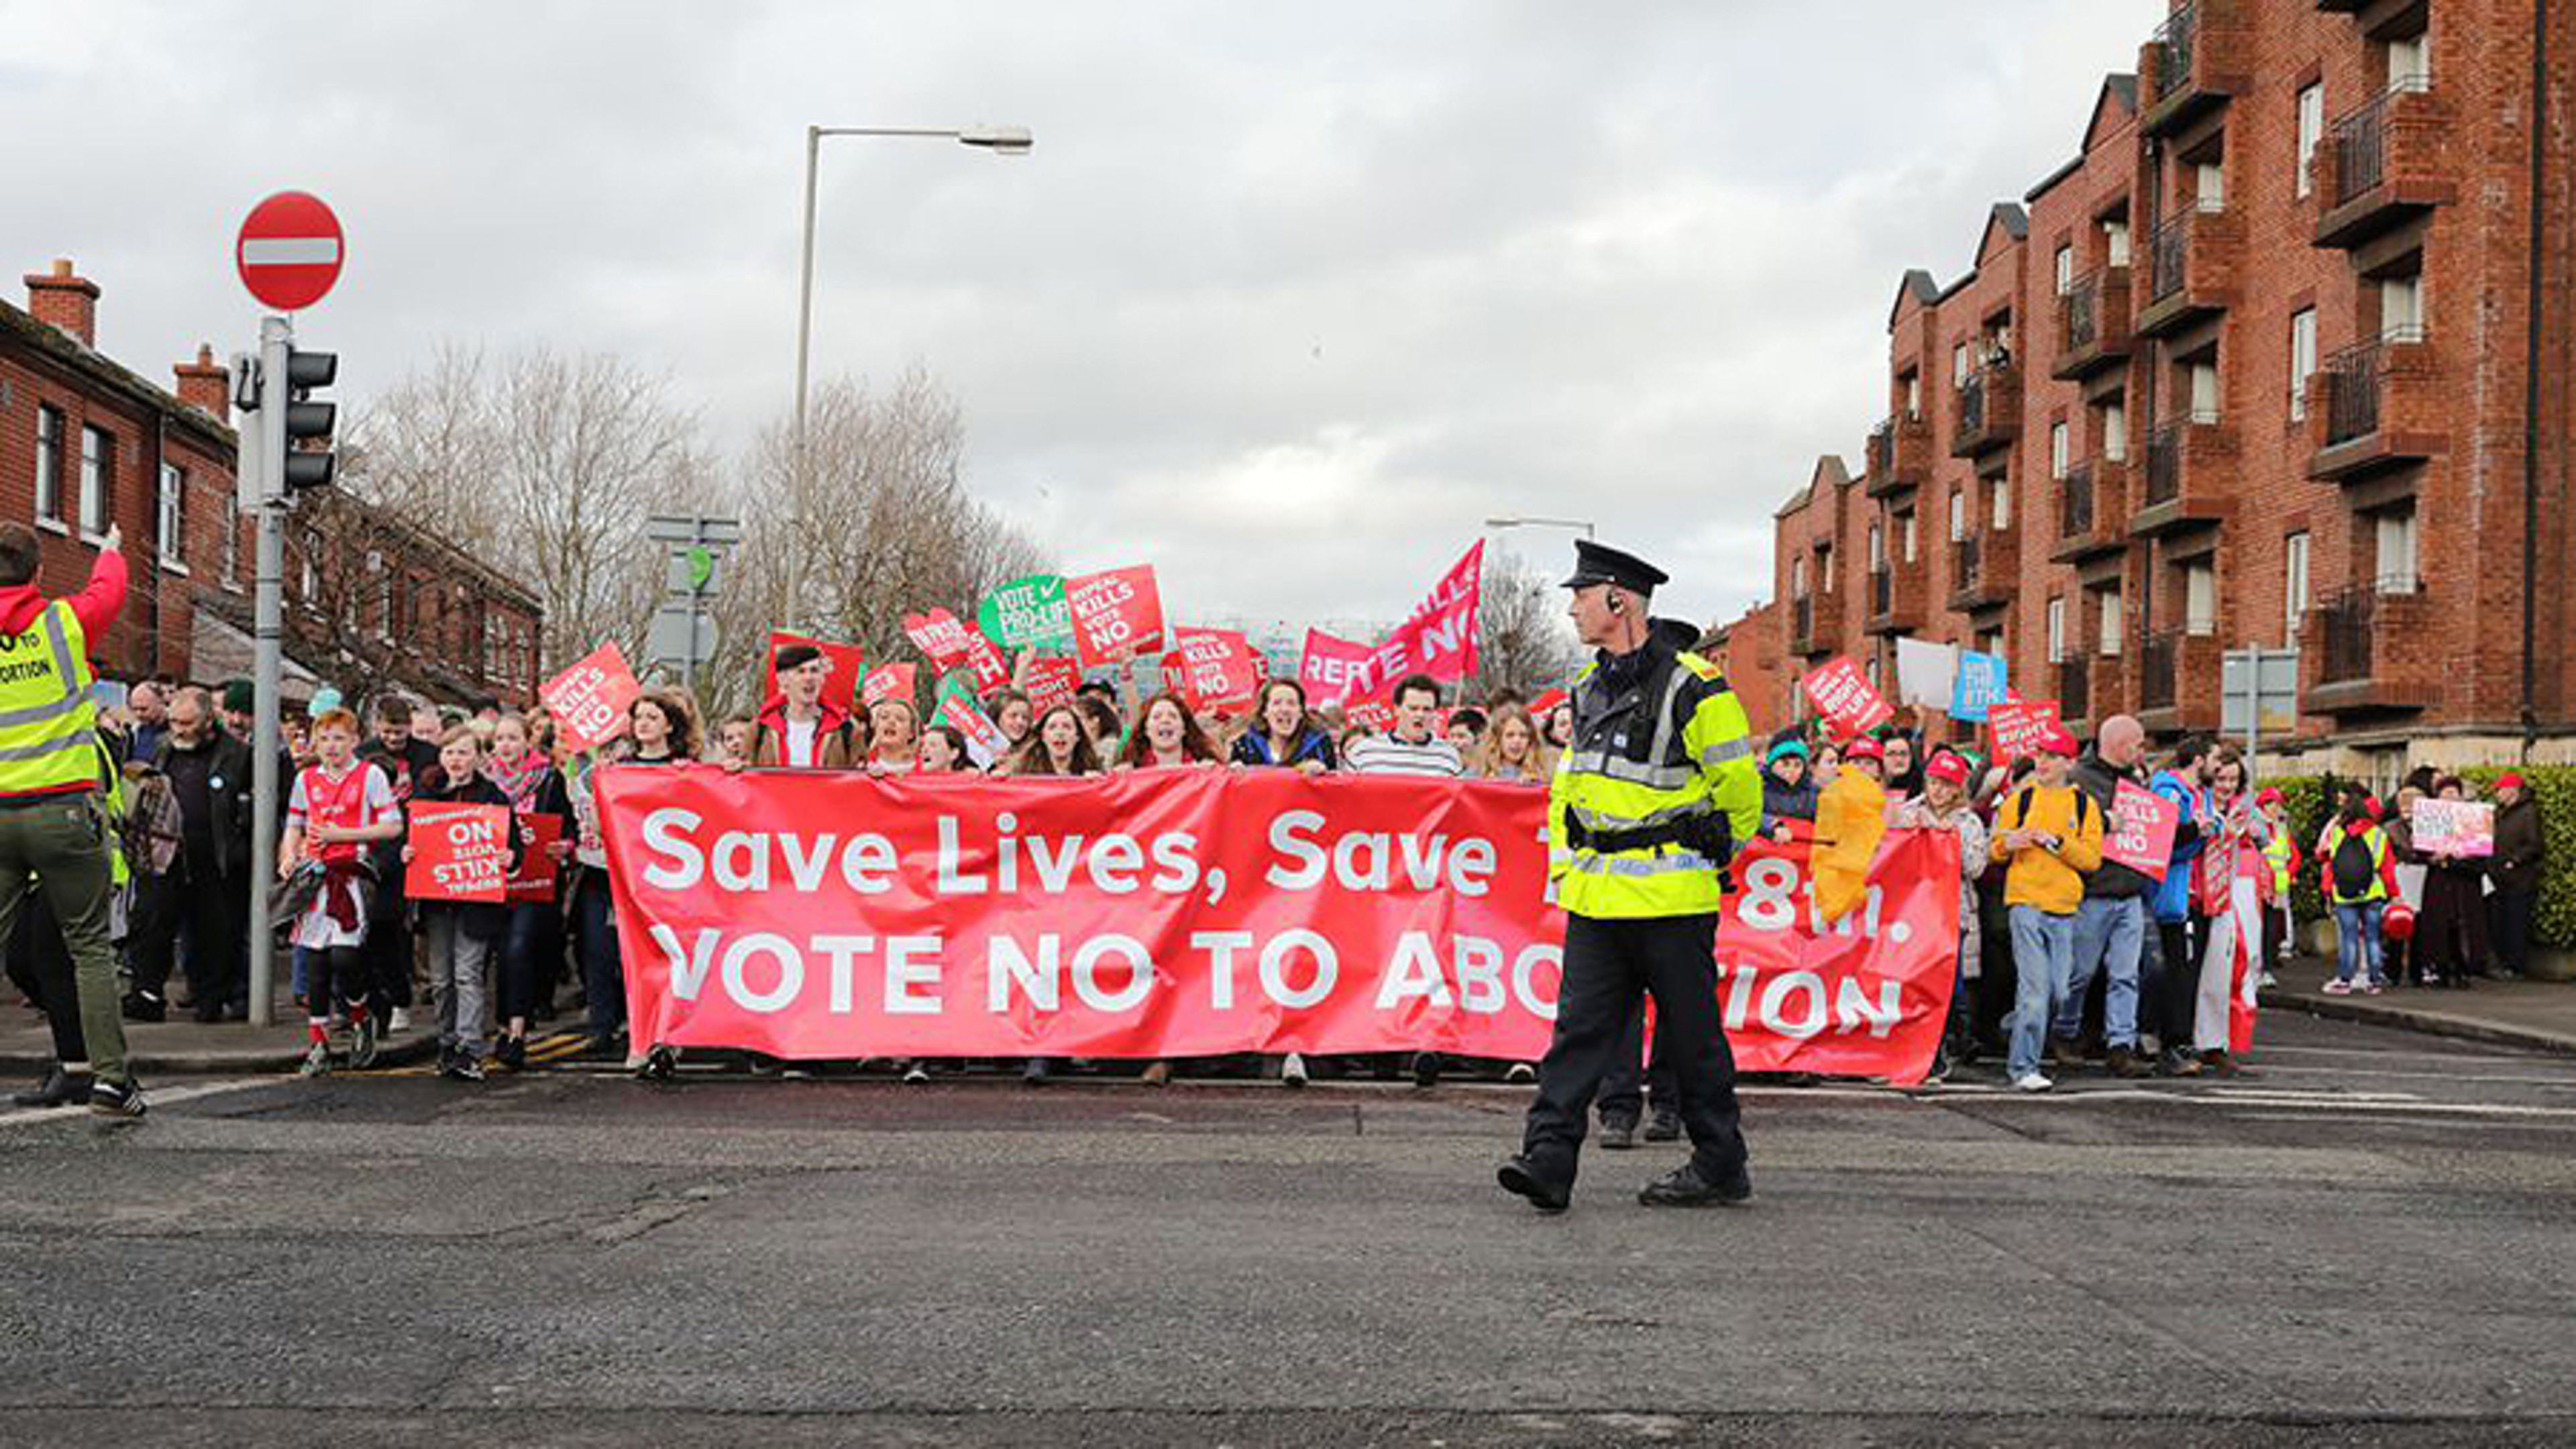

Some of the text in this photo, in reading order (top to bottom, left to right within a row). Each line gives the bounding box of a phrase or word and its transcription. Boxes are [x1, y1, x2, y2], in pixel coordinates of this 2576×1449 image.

[997, 586, 1038, 613] VOTE
[1076, 582, 1134, 619] KILLS
[1082, 608, 1122, 631] VOTE
[21, 633, 40, 648] TO
[1090, 620, 1131, 651] NO
[1184, 642, 1232, 662] KILLS
[555, 667, 605, 717] KILLS
[1196, 673, 1228, 698] NO
[1823, 676, 1860, 714] RIGHT
[572, 695, 599, 725] VOTE
[578, 704, 613, 739] NO
[1997, 720, 2047, 745] RIGHT
[449, 821, 493, 845] NO
[2116, 833, 2147, 851] NO
[453, 843, 497, 860] VOTE
[642, 806, 898, 894] Save
[938, 812, 1228, 905] Lives,
[1265, 809, 1497, 896] Save
[432, 858, 498, 883] KILLS
[649, 924, 1902, 1040] VOTE NO TO ABOION
